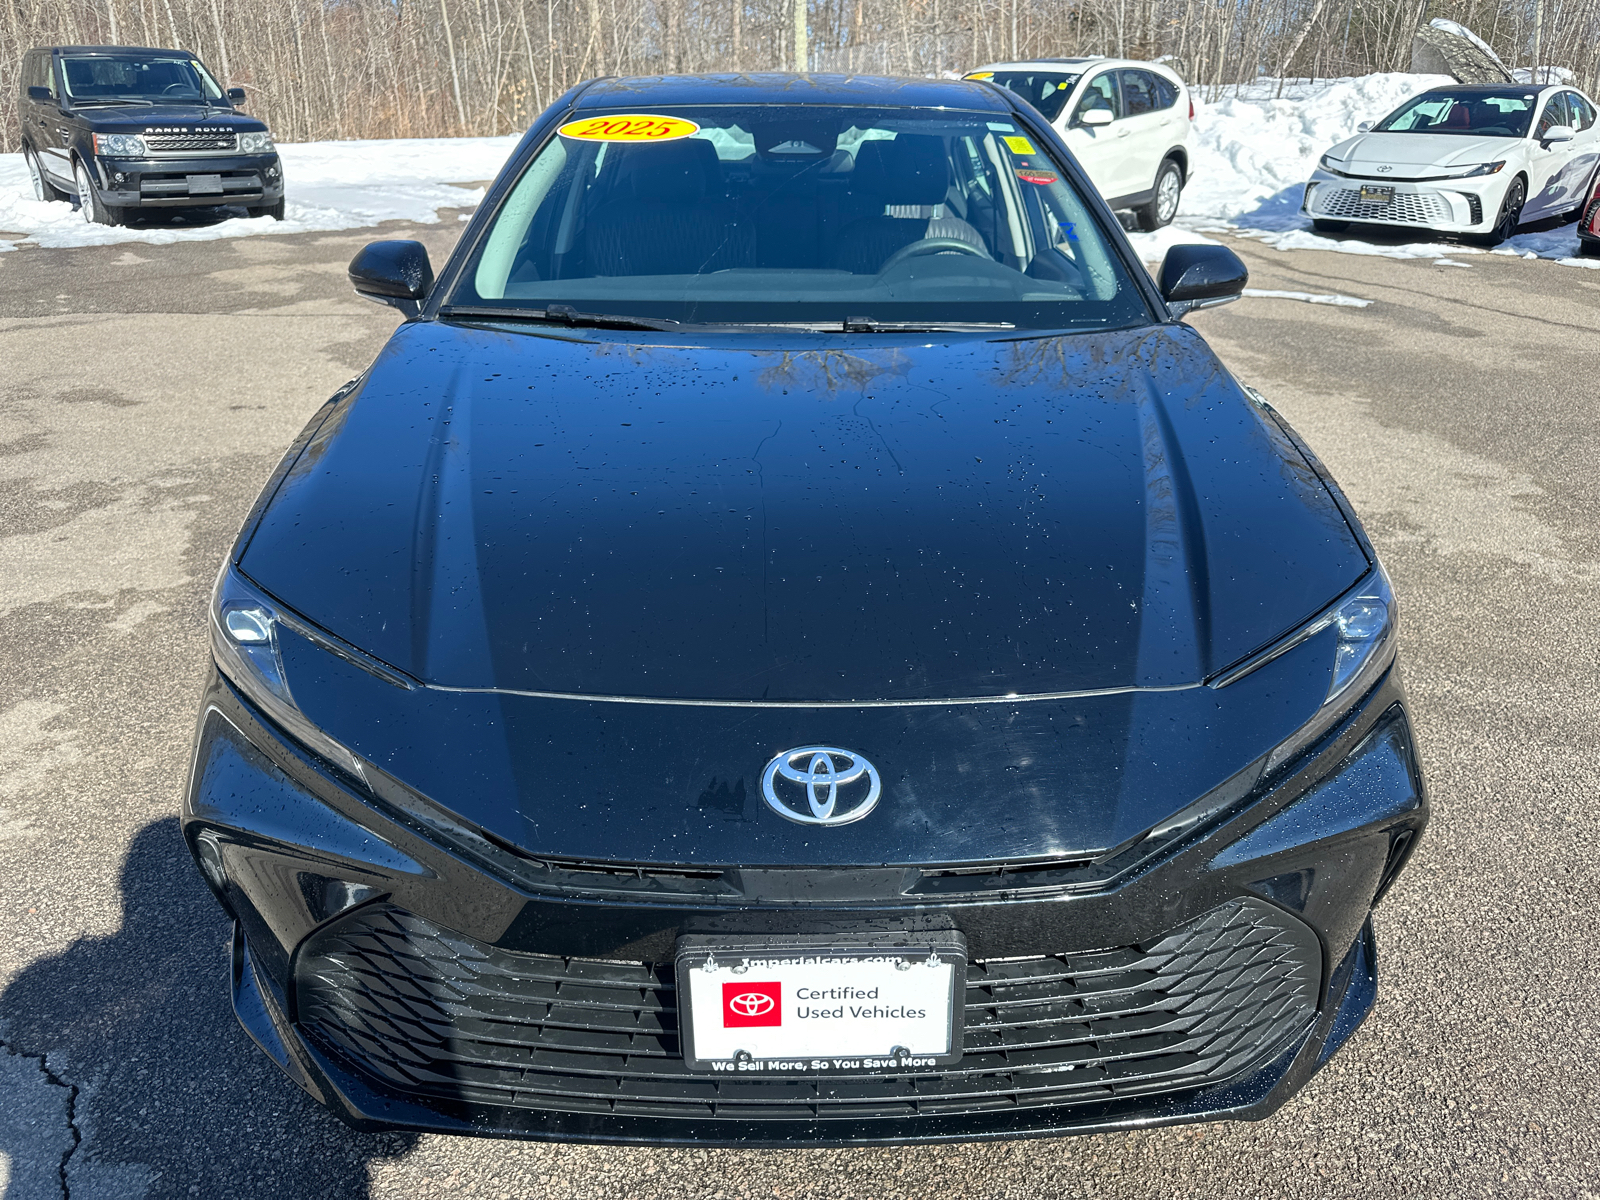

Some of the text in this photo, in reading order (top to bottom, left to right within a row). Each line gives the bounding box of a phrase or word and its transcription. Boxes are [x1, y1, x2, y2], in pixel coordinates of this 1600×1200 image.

[577, 121, 679, 137] 2025
[796, 986, 879, 1000] Certified
[797, 1005, 926, 1019] Used Vehicles
[711, 1057, 936, 1072] We Sell More, So You Save More
